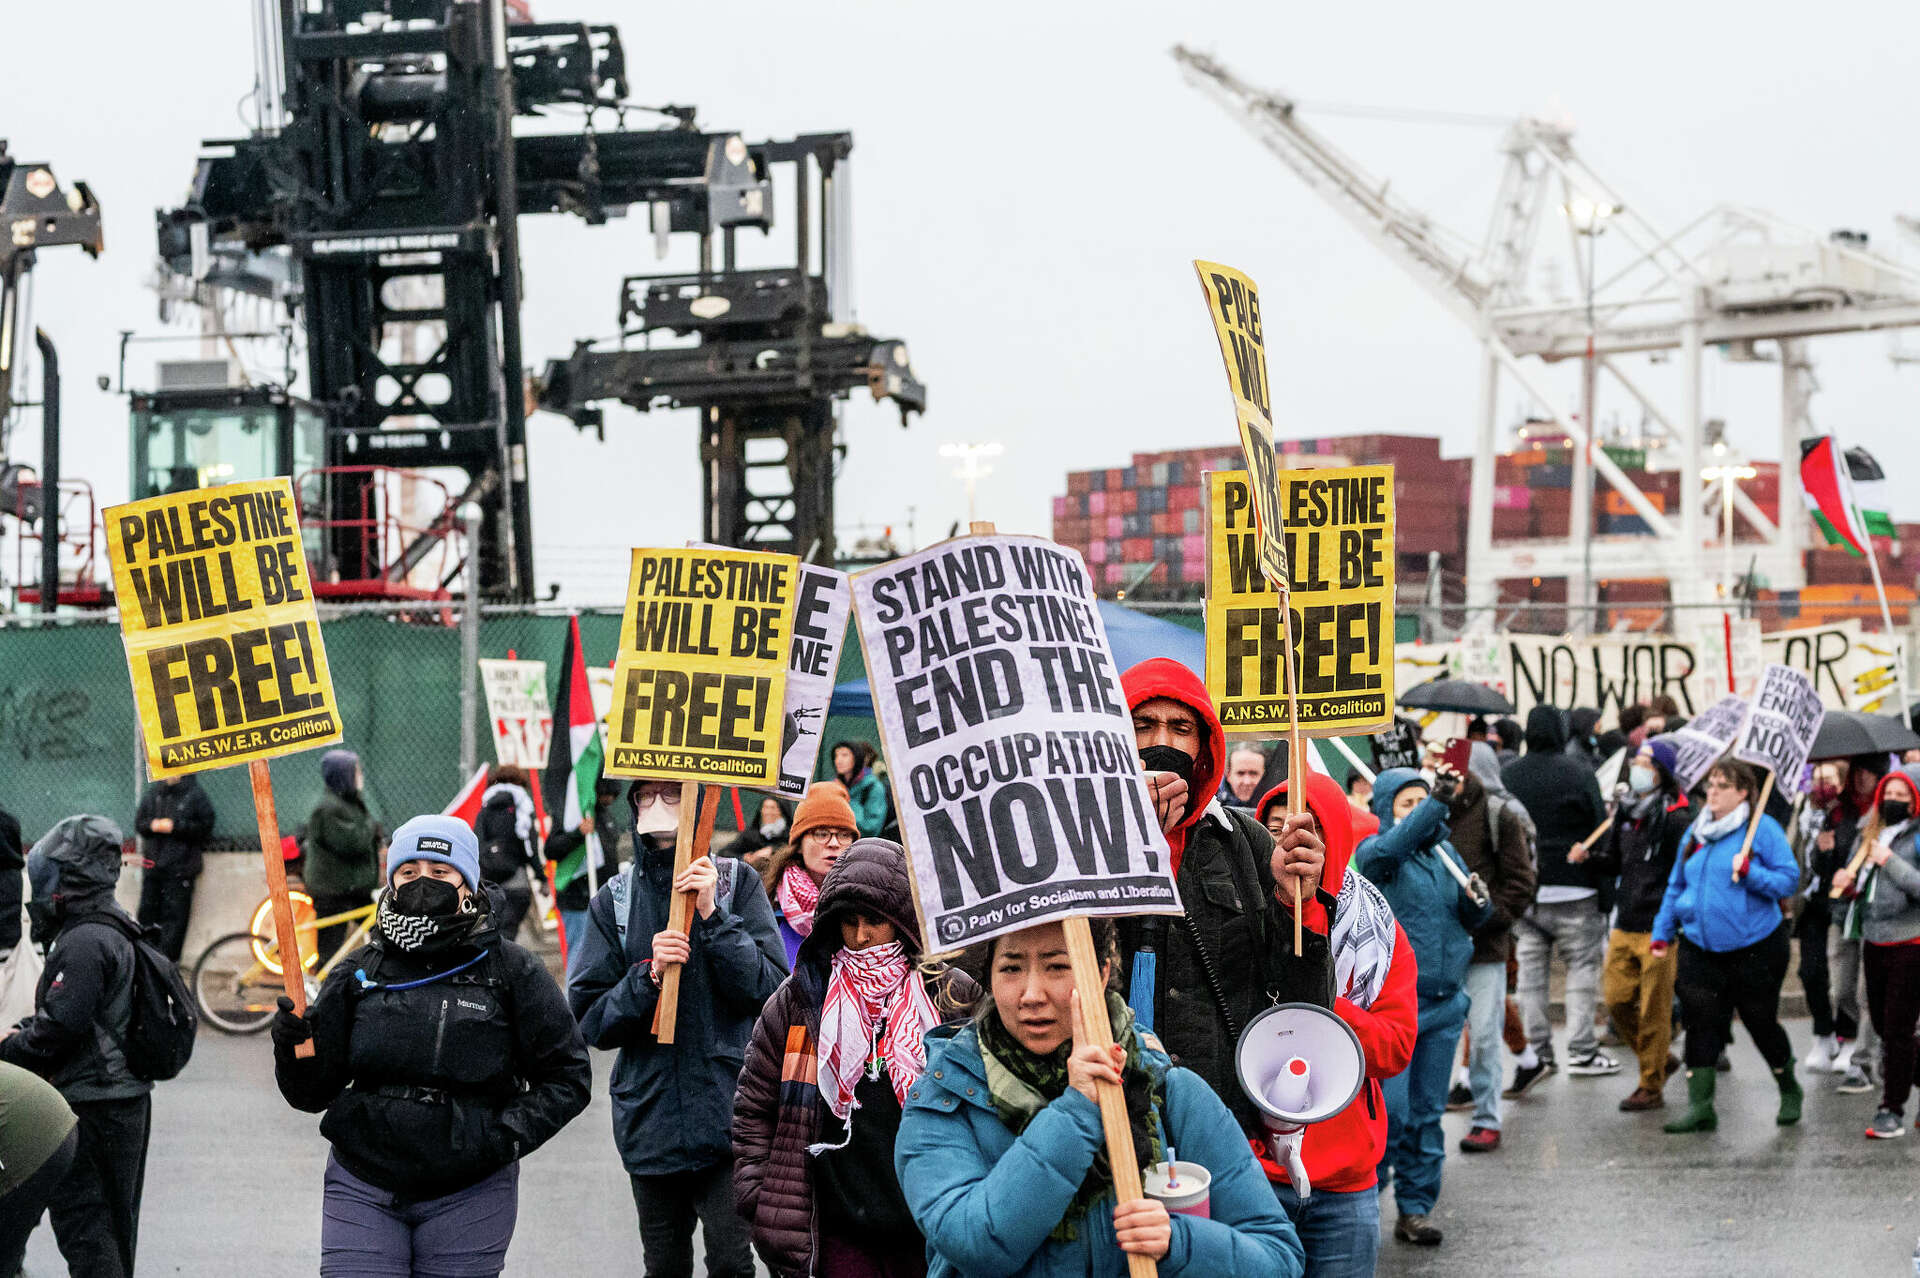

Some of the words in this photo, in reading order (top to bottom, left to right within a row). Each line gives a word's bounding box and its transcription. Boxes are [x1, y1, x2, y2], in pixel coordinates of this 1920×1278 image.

[120, 490, 293, 564] PALESTINE
[1339, 528, 1384, 590] BE
[130, 551, 252, 629] WILL
[255, 541, 304, 606] BE
[638, 557, 788, 604] PALESTINE
[873, 545, 1007, 625] STAND
[1008, 545, 1085, 599] WITH
[635, 601, 719, 656] WILL
[730, 605, 781, 660] BE
[884, 594, 1100, 678] PALESTINE!
[1225, 602, 1382, 697] FREE!
[147, 620, 324, 739] FREE!
[620, 668, 772, 753] FREE!
[895, 648, 1025, 749] END
[1029, 646, 1123, 717] THE
[1224, 703, 1317, 721] A.N.S.W..R.
[1319, 700, 1383, 717] Coalition
[1510, 642, 1577, 714] NO
[167, 734, 267, 764] A.N.S.W.E.R.
[270, 719, 332, 744] Coalition
[616, 754, 697, 769] A.N.S.W.E.R.
[699, 757, 763, 774] Coalition
[909, 730, 1137, 811] OCCUPATION
[923, 777, 1160, 912] NOW!
[969, 908, 1004, 929] Party
[1006, 901, 1026, 916] for
[1029, 889, 1096, 909] Socialism
[1098, 887, 1120, 899] and
[1121, 885, 1173, 899] Liberation
